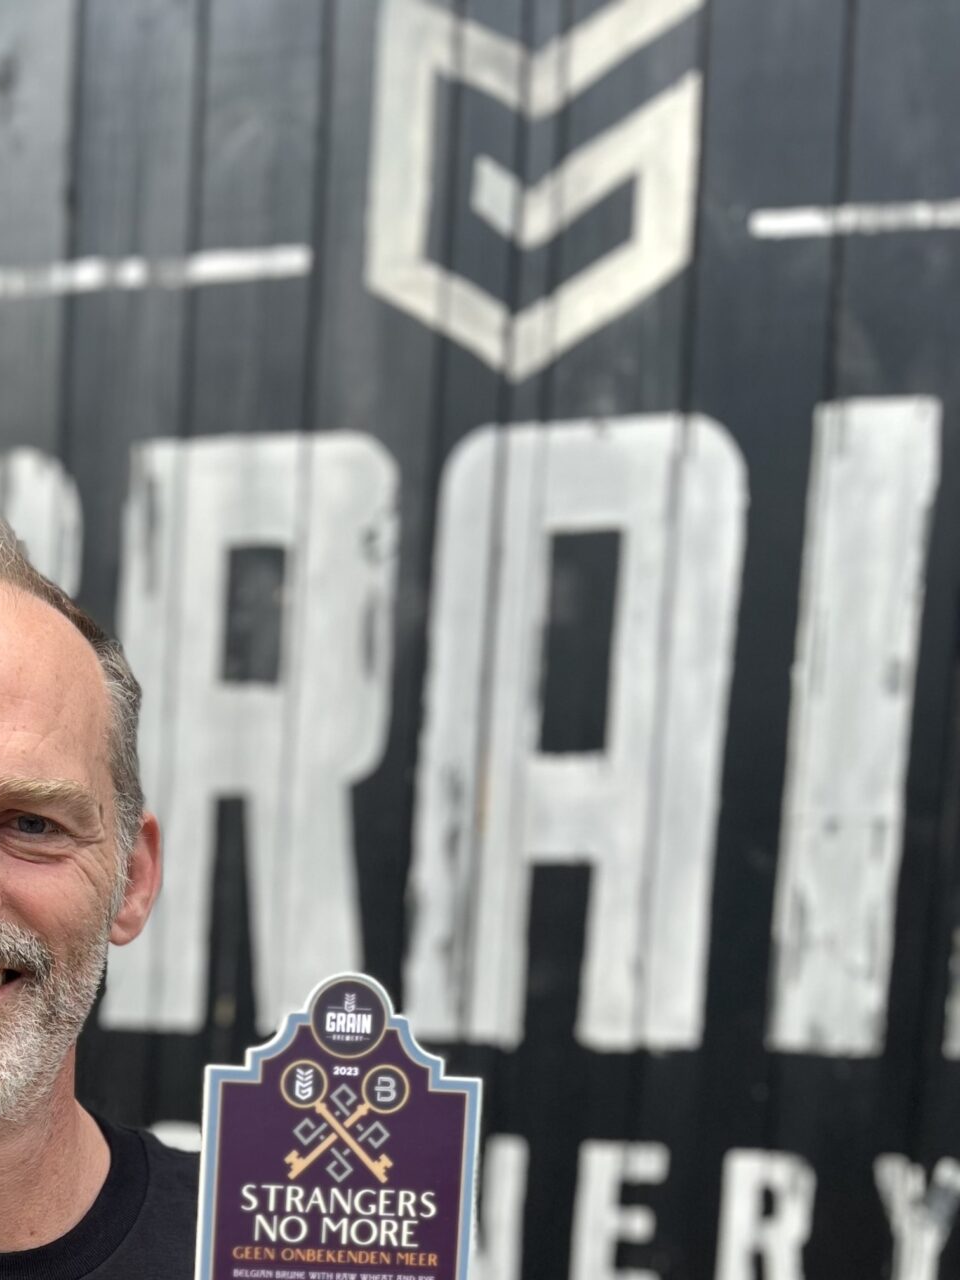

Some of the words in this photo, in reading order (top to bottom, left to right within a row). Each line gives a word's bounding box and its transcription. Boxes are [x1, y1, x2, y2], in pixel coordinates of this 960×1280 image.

[326, 1012, 372, 1034] GRAIN
[333, 1066, 359, 1076] 2023
[240, 1184, 437, 1218] STRANGERS
[254, 1214, 308, 1243] NO
[321, 1217, 419, 1248] MORE
[232, 1246, 275, 1260] GEEN
[281, 1248, 391, 1265] ONBEKENDEN
[396, 1252, 438, 1267] MEER
[233, 1269, 273, 1279] BELGIAN
[308, 1271, 334, 1280] WITH
